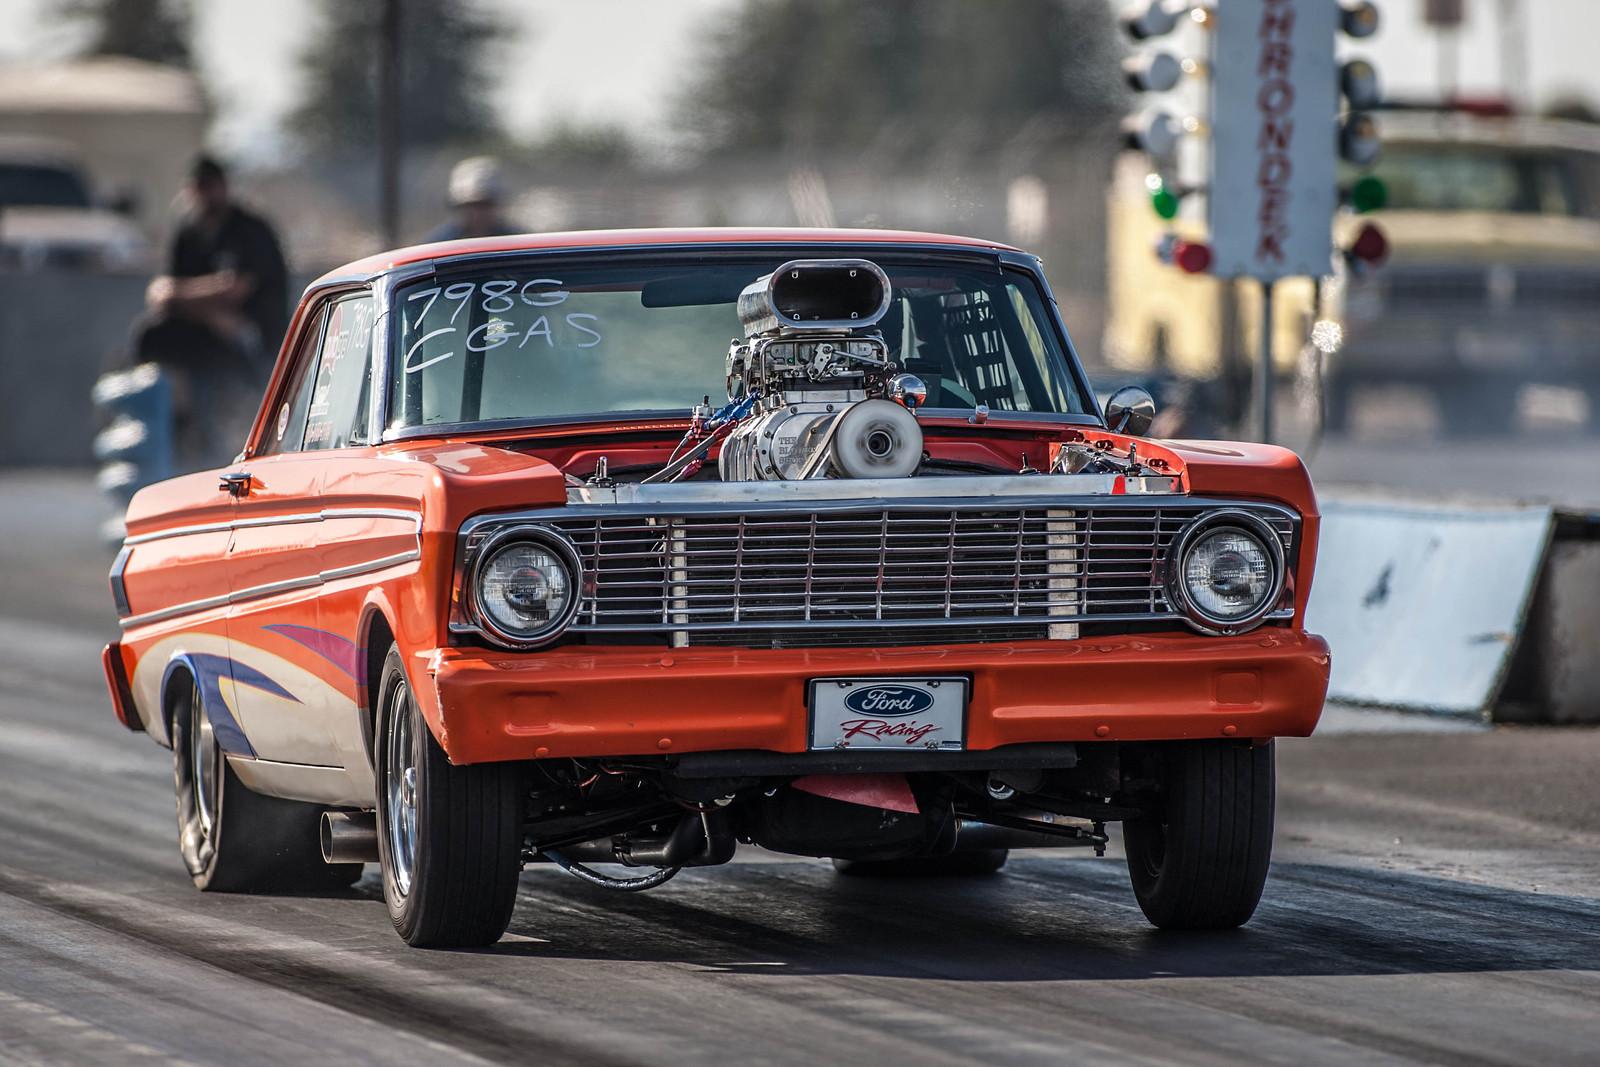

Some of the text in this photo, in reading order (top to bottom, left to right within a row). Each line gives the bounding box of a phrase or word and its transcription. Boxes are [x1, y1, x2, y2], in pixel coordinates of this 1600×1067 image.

[1255, 0, 1297, 263] HRONDEK
[407, 278, 571, 330] 798G
[405, 312, 602, 374] C GAS
[778, 436, 798, 445] THE
[861, 688, 917, 711] Ford
[840, 719, 943, 745] Racing
